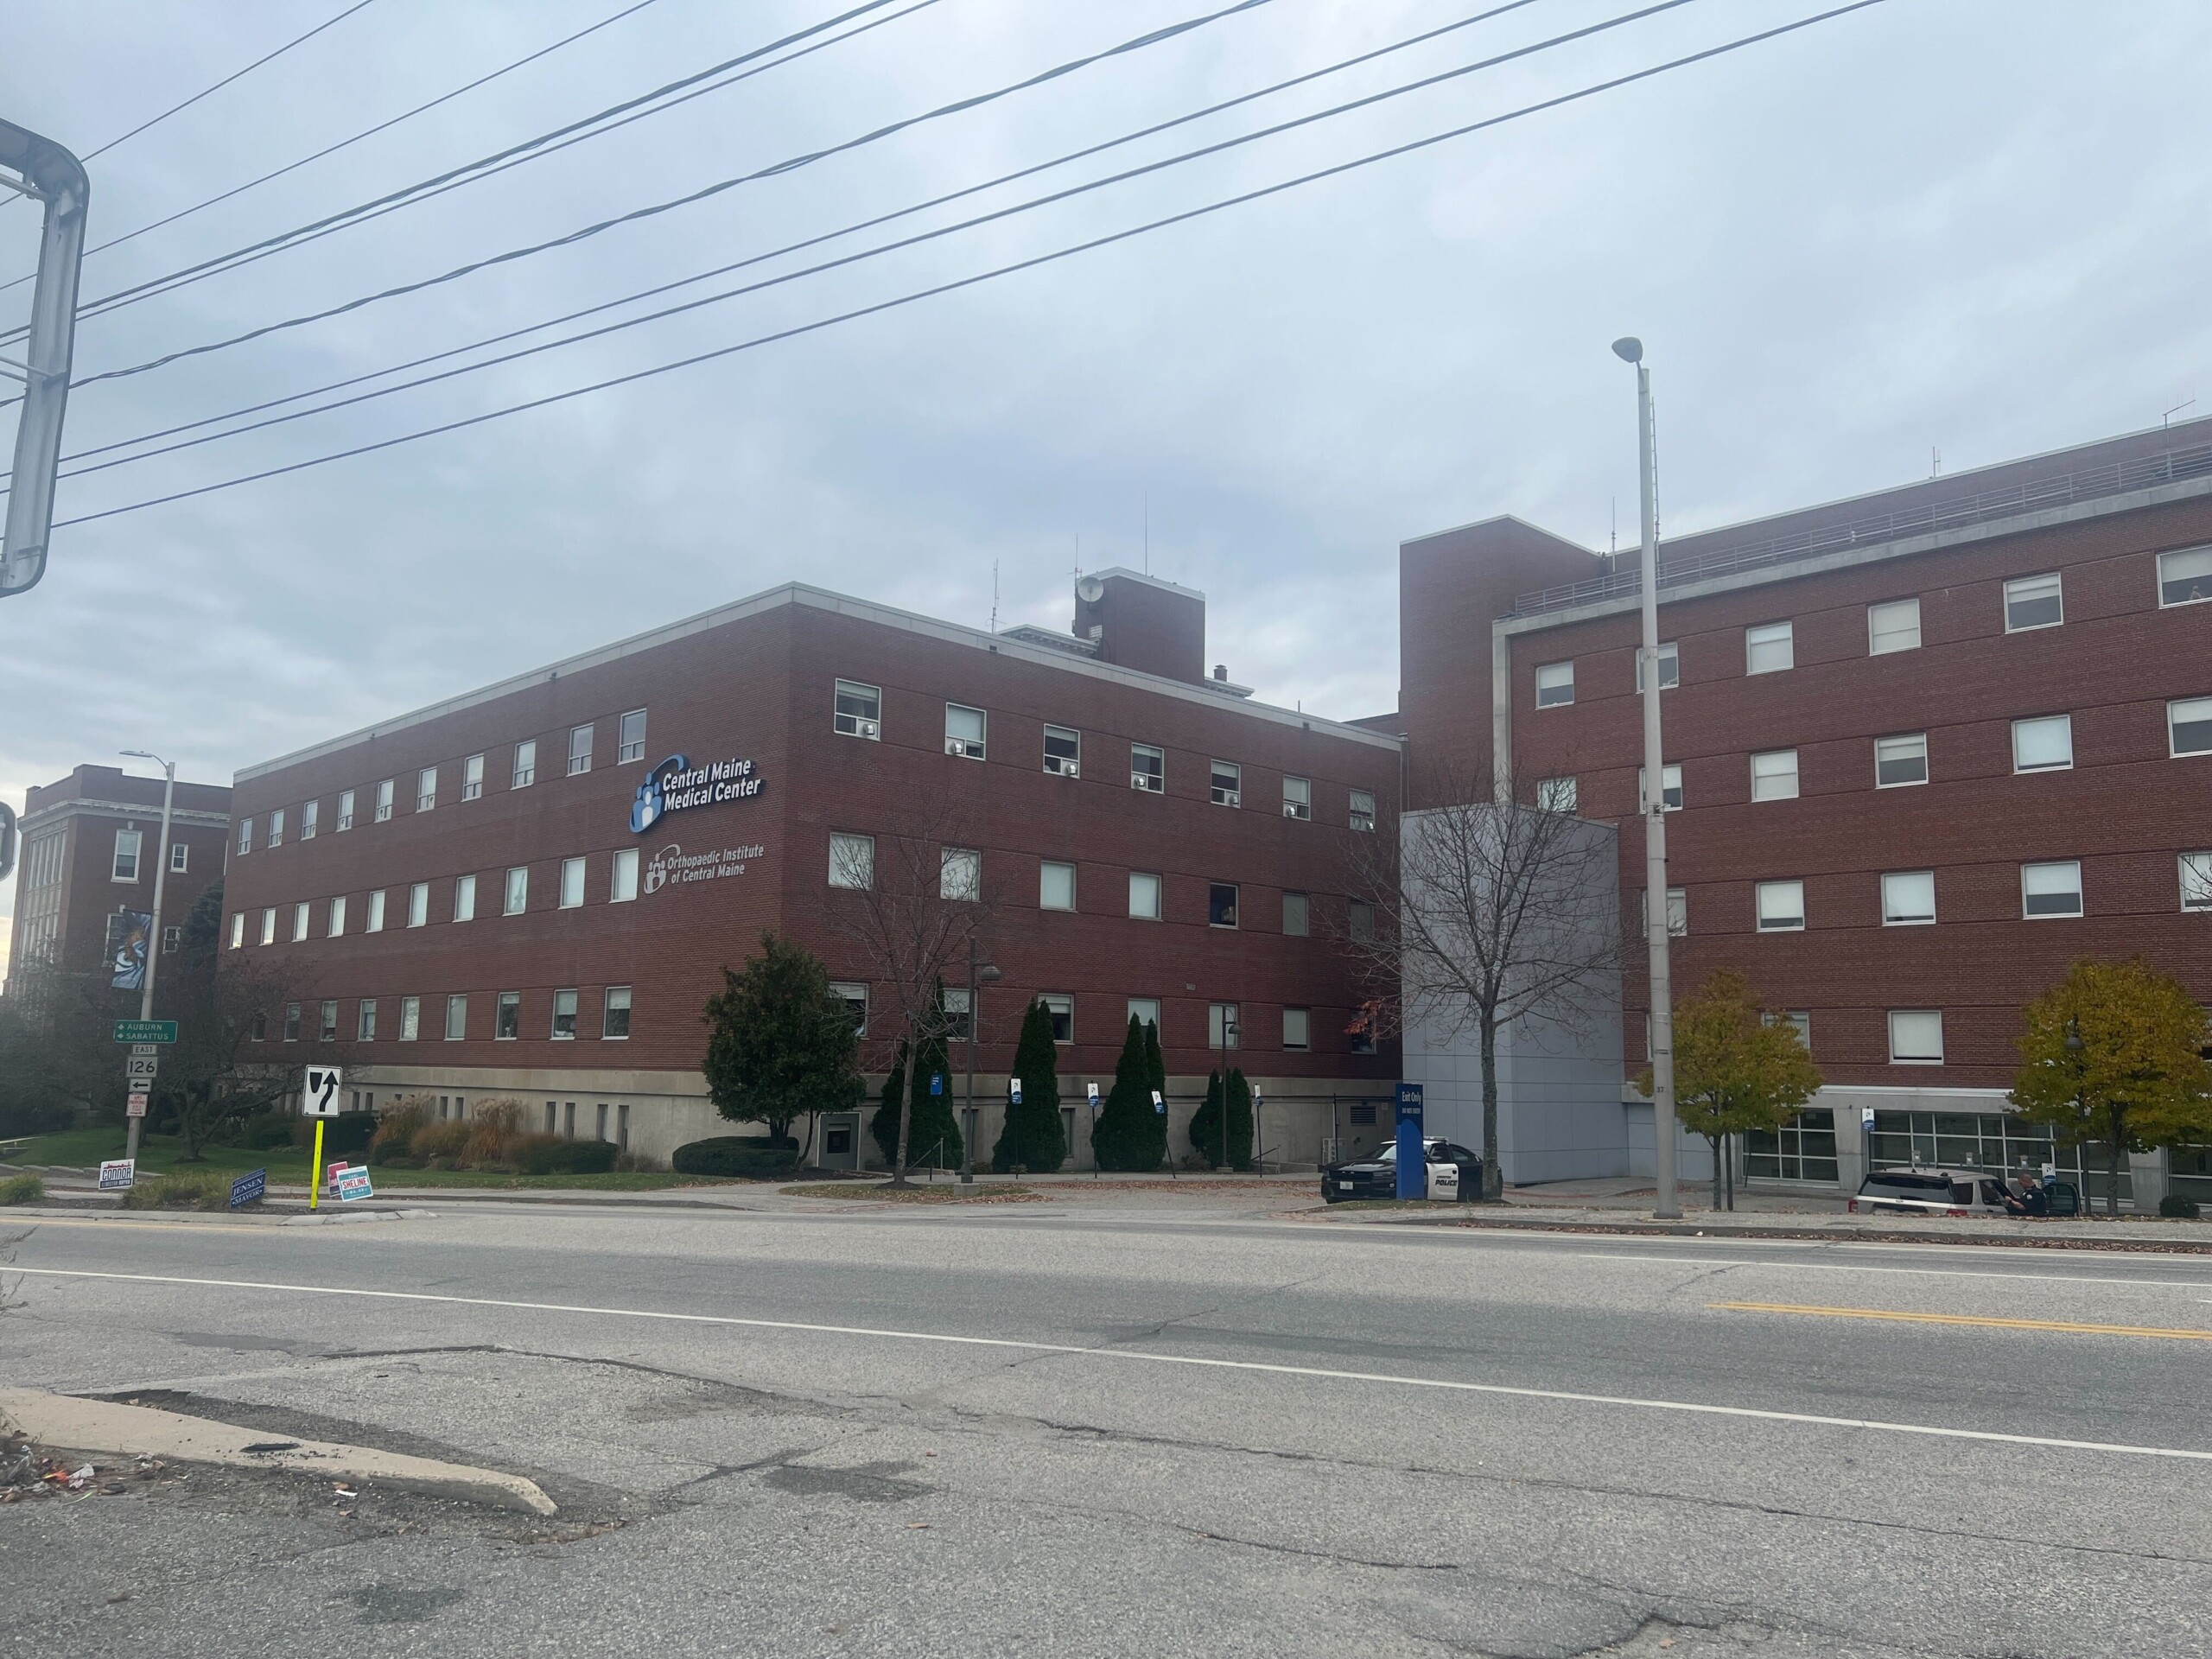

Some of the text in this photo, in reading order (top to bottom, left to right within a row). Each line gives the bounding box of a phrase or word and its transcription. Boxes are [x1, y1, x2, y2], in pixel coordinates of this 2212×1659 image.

[663, 758, 751, 791] Central Maine
[664, 779, 761, 811] Medical Center
[667, 843, 765, 870] Orthopaedic Institute
[671, 862, 745, 884] of Central Maine
[129, 1061, 156, 1073] 126
[1402, 1091, 1421, 1105] Exit Only
[102, 1167, 131, 1181] CONNOR
[342, 1177, 366, 1190] SHELINE
[232, 1177, 263, 1198] JENSEN
